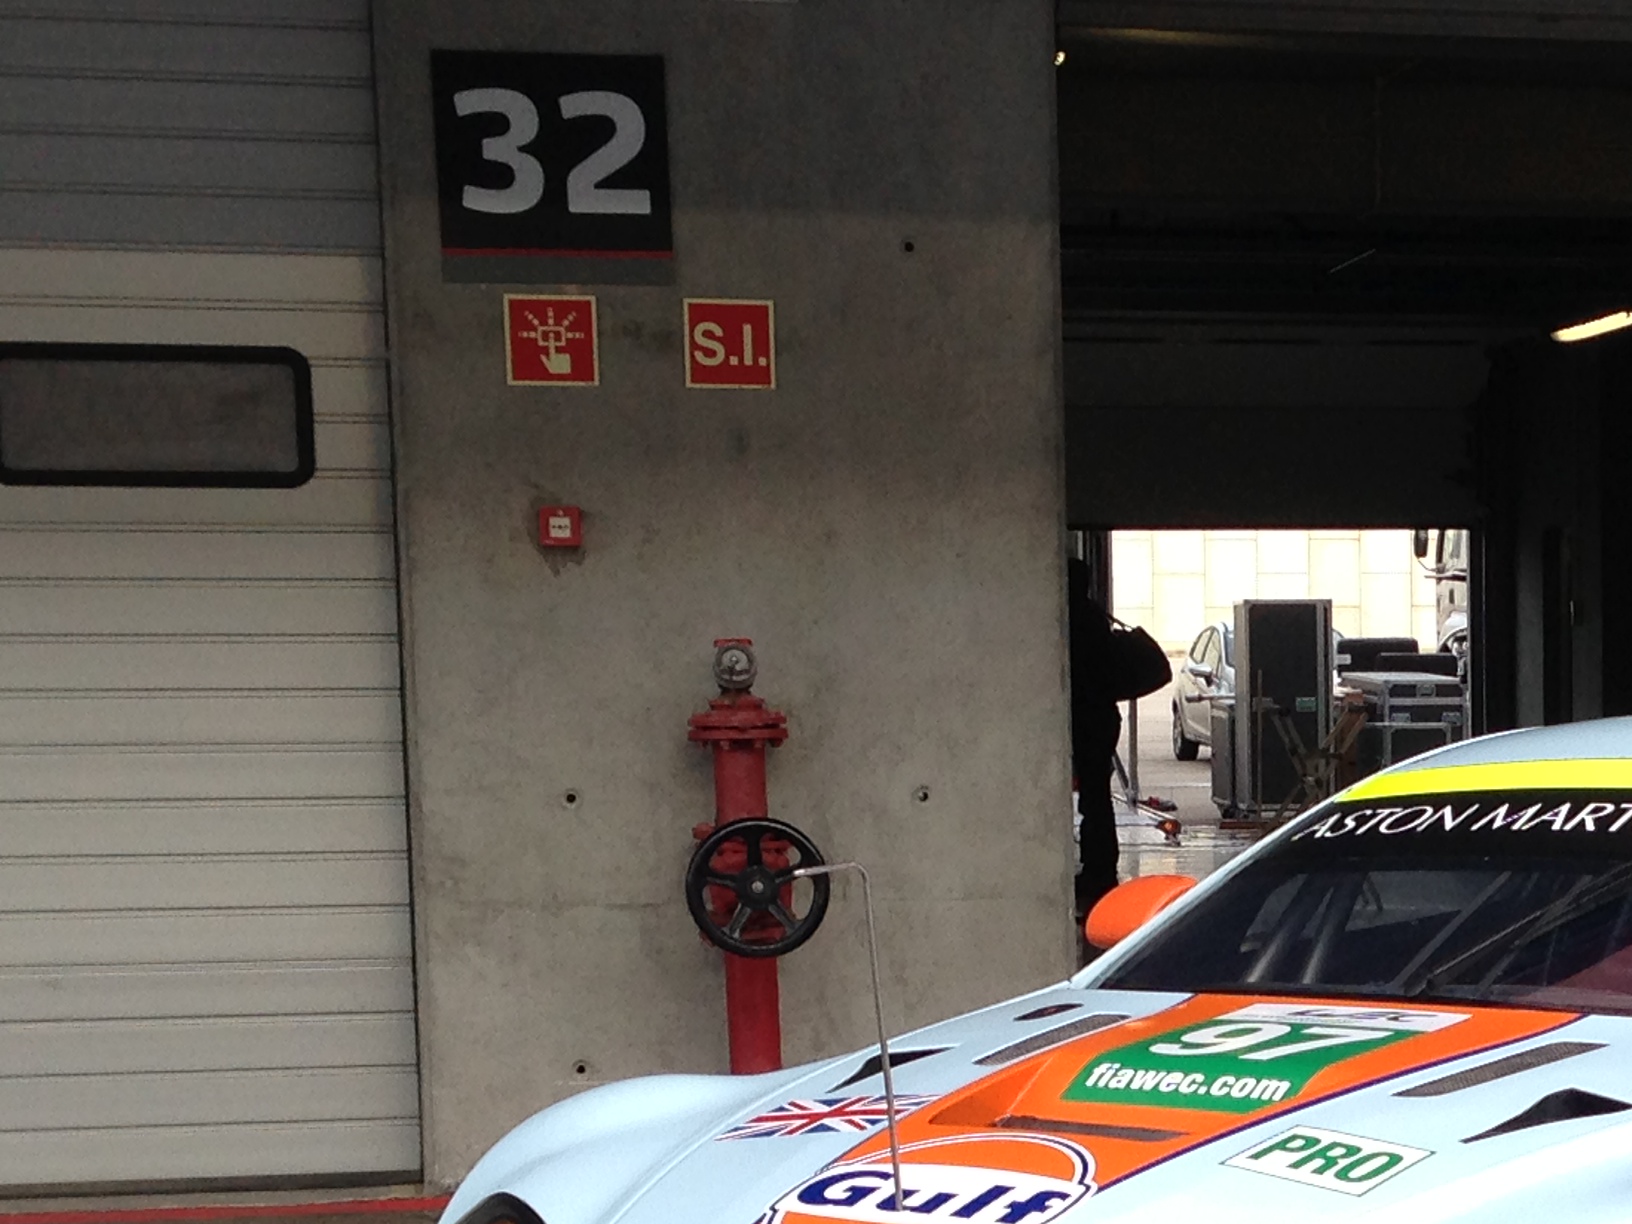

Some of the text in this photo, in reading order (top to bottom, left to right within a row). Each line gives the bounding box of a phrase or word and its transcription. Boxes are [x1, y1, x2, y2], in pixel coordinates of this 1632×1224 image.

[453, 87, 651, 214] 32
[693, 322, 768, 366] S.I.
[1291, 803, 1480, 841] ASTON
[1149, 1022, 1395, 1062] 97
[1085, 1062, 1291, 1101] fiawec.com
[1249, 1133, 1404, 1183] PRO
[797, 1170, 1072, 1224] Gulf
